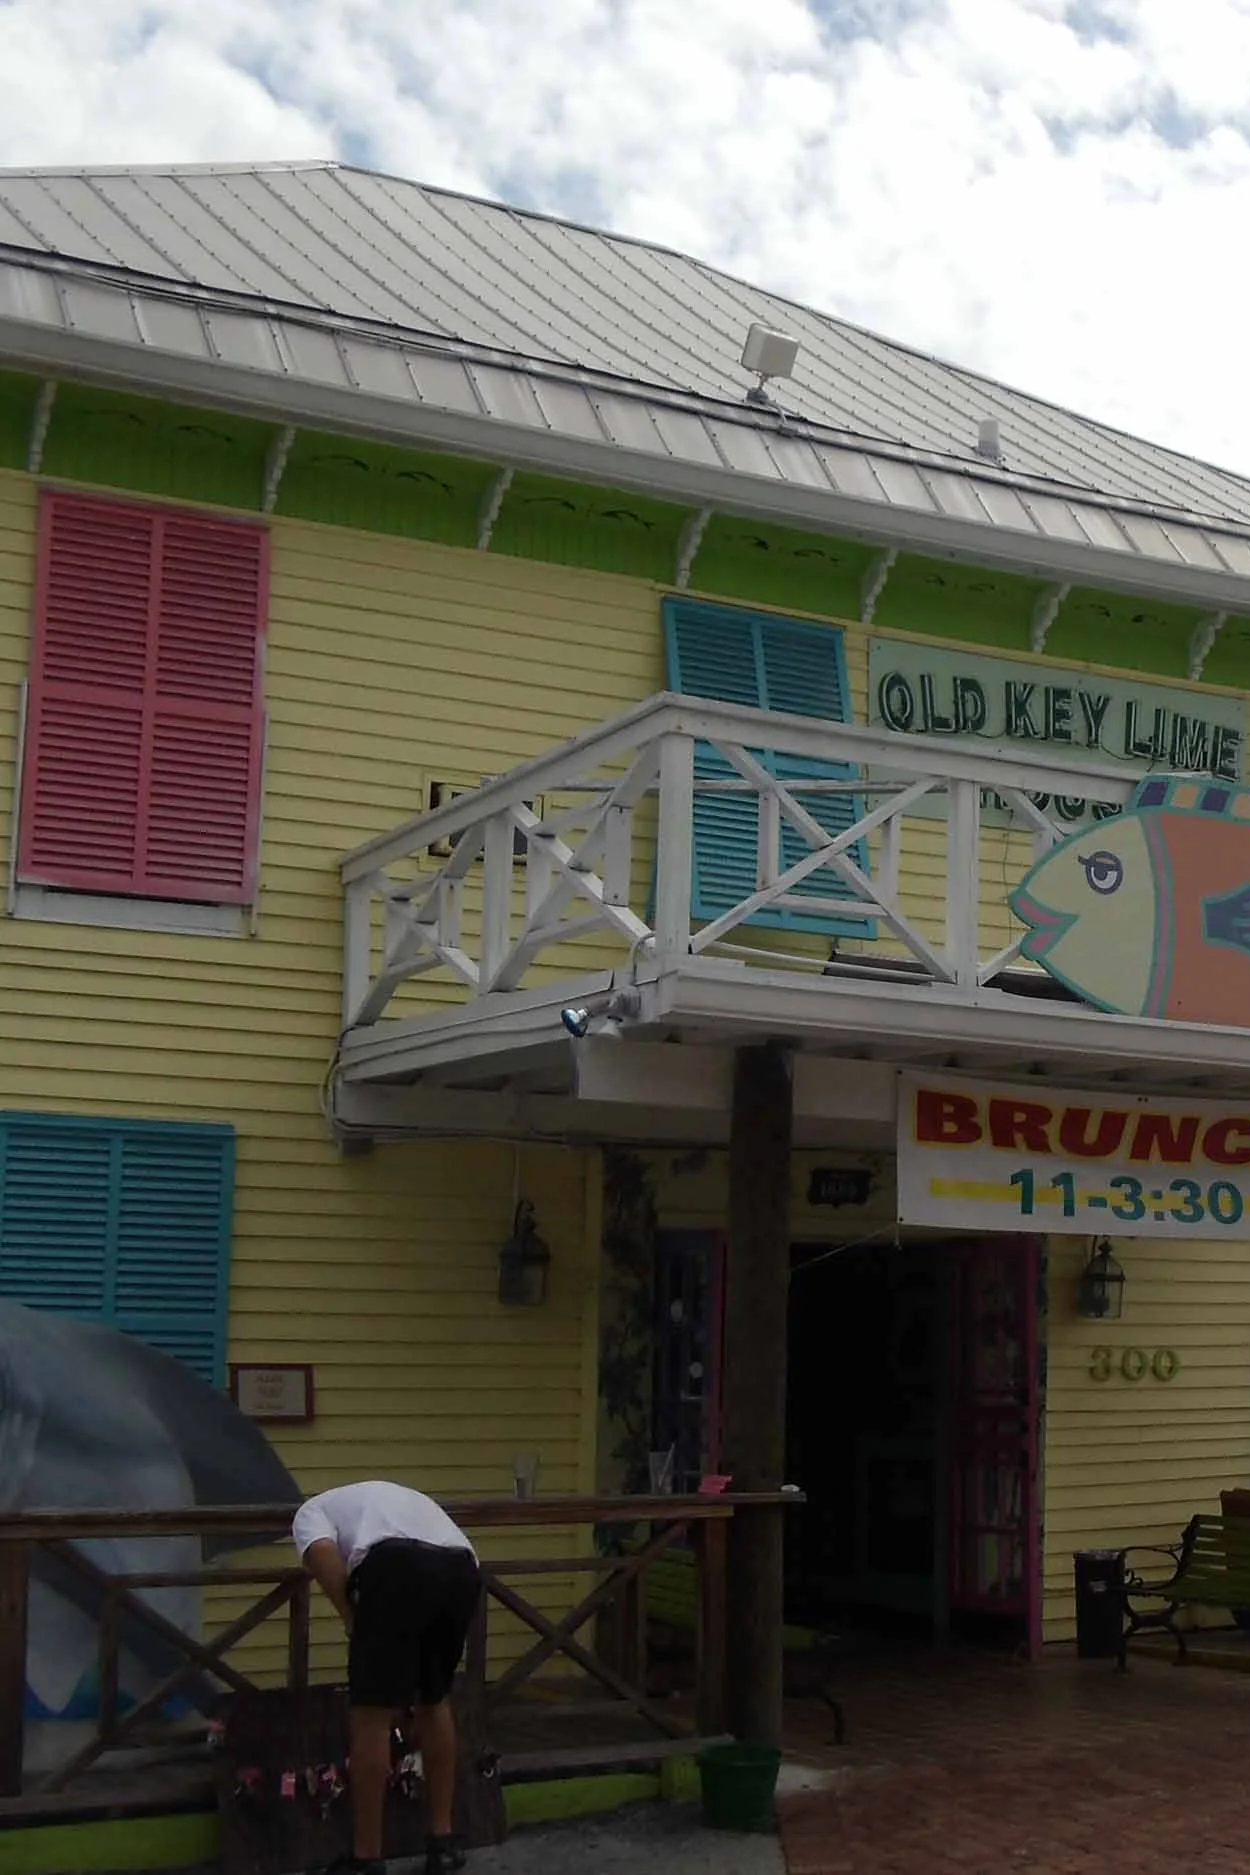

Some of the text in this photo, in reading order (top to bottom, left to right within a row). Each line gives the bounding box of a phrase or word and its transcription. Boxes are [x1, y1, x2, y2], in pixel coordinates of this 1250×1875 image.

[880, 671, 1242, 781] OLD KEY LIME
[1009, 1168, 1244, 1224] 11-3:30
[1089, 1347, 1178, 1382] 300
